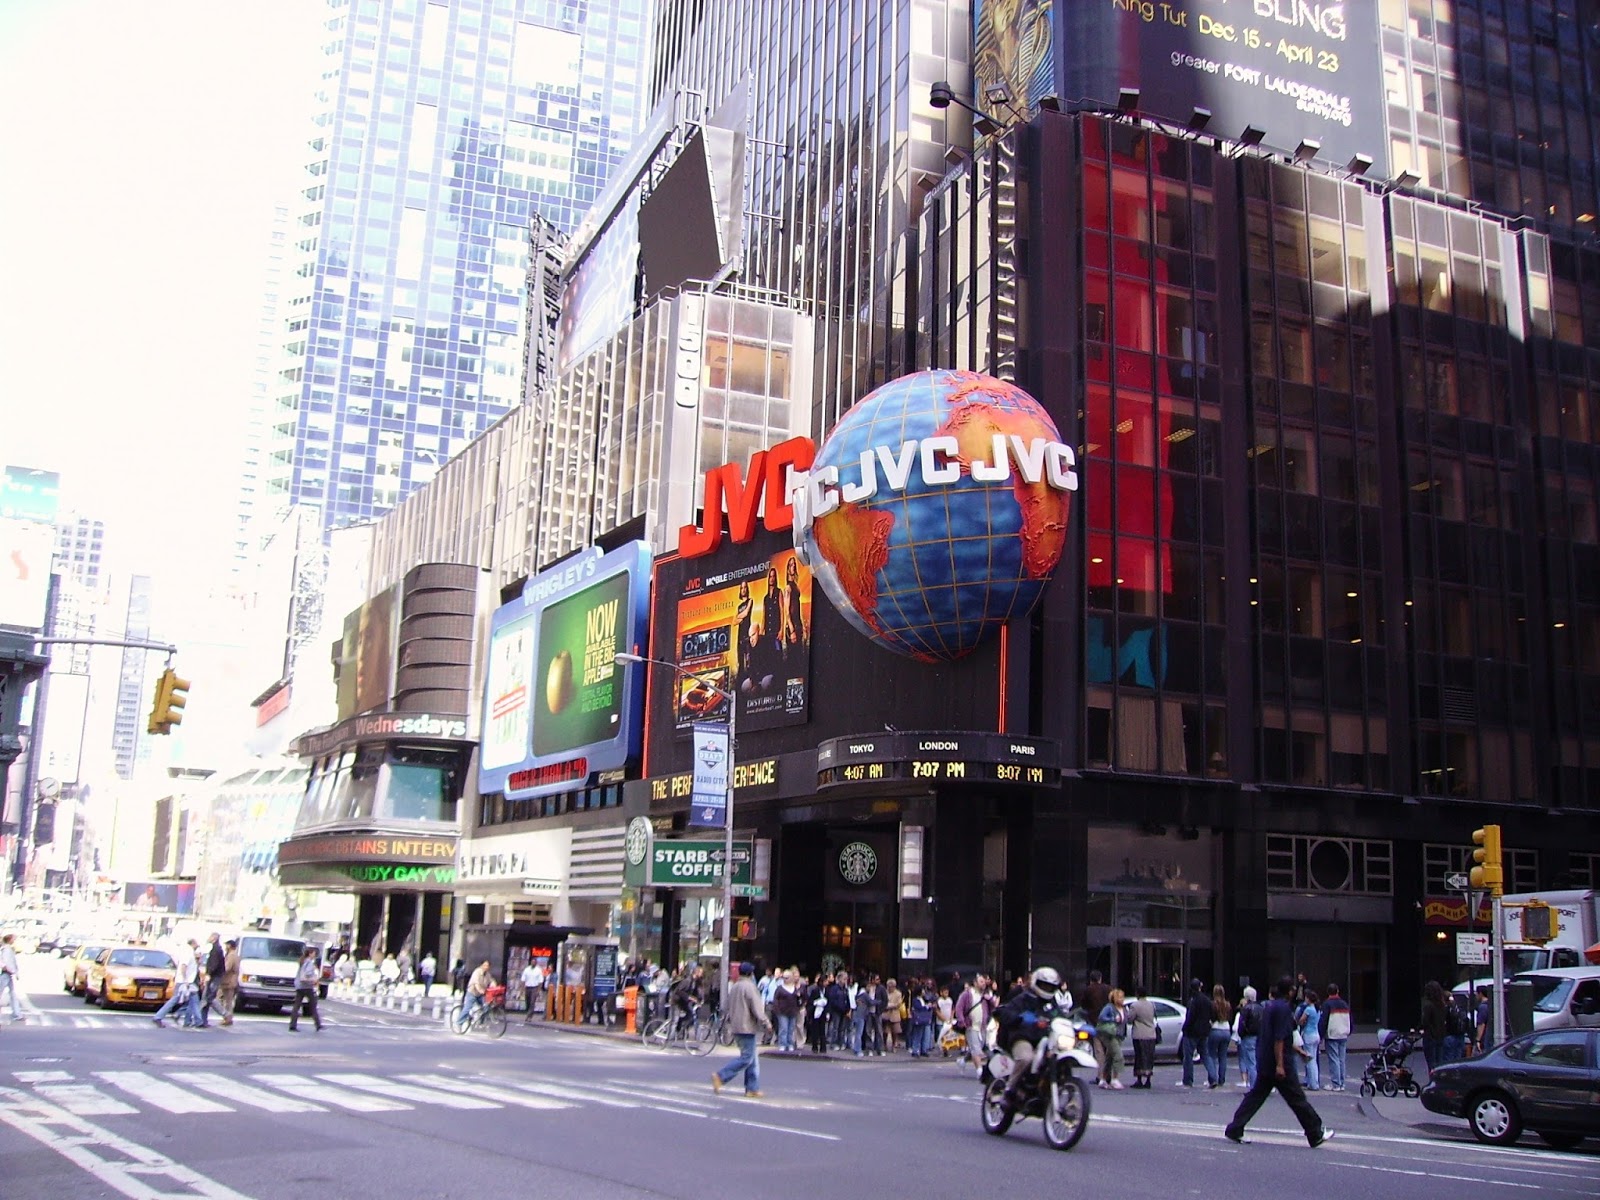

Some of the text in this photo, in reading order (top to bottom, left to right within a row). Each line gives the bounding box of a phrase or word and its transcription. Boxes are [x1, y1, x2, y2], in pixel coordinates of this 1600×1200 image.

[1160, 3, 1187, 28] Tut
[1199, 15, 1238, 43] Dec.
[1243, 28, 1261, 49] 15
[1276, 39, 1313, 65] April
[1317, 50, 1340, 73] 23
[1171, 51, 1350, 110] greater FORT LAUDERDALE
[1296, 98, 1352, 127] sunny.org
[842, 437, 961, 503] JVC
[971, 434, 1079, 491] JVC
[678, 436, 816, 558] JVC
[524, 555, 597, 607] WRIGLEY'S
[686, 578, 701, 592] JVC
[705, 573, 728, 587] MOBILE
[586, 599, 618, 645] NOW
[584, 652, 592, 671] IN
[592, 647, 604, 668] THE
[604, 643, 616, 664] BIG
[355, 714, 467, 738] Wednesdays
[849, 743, 874, 754] TOKYO
[919, 741, 958, 751] LONDON
[1010, 744, 1035, 755] PARIS
[844, 764, 864, 780] 4:07
[869, 764, 883, 778] AM
[912, 761, 940, 777] 7:07
[946, 761, 965, 778] PM
[997, 764, 1021, 781] 8:07
[652, 779, 668, 800] THE
[336, 840, 388, 854] OBTAINS
[841, 844, 875, 863] STARBUCKS
[393, 866, 429, 882] GAY
[844, 870, 871, 882] COFFEE
[1451, 876, 1466, 885] ONE
[1432, 904, 1489, 920] MANHAAN
[1558, 908, 1577, 919] PORT
